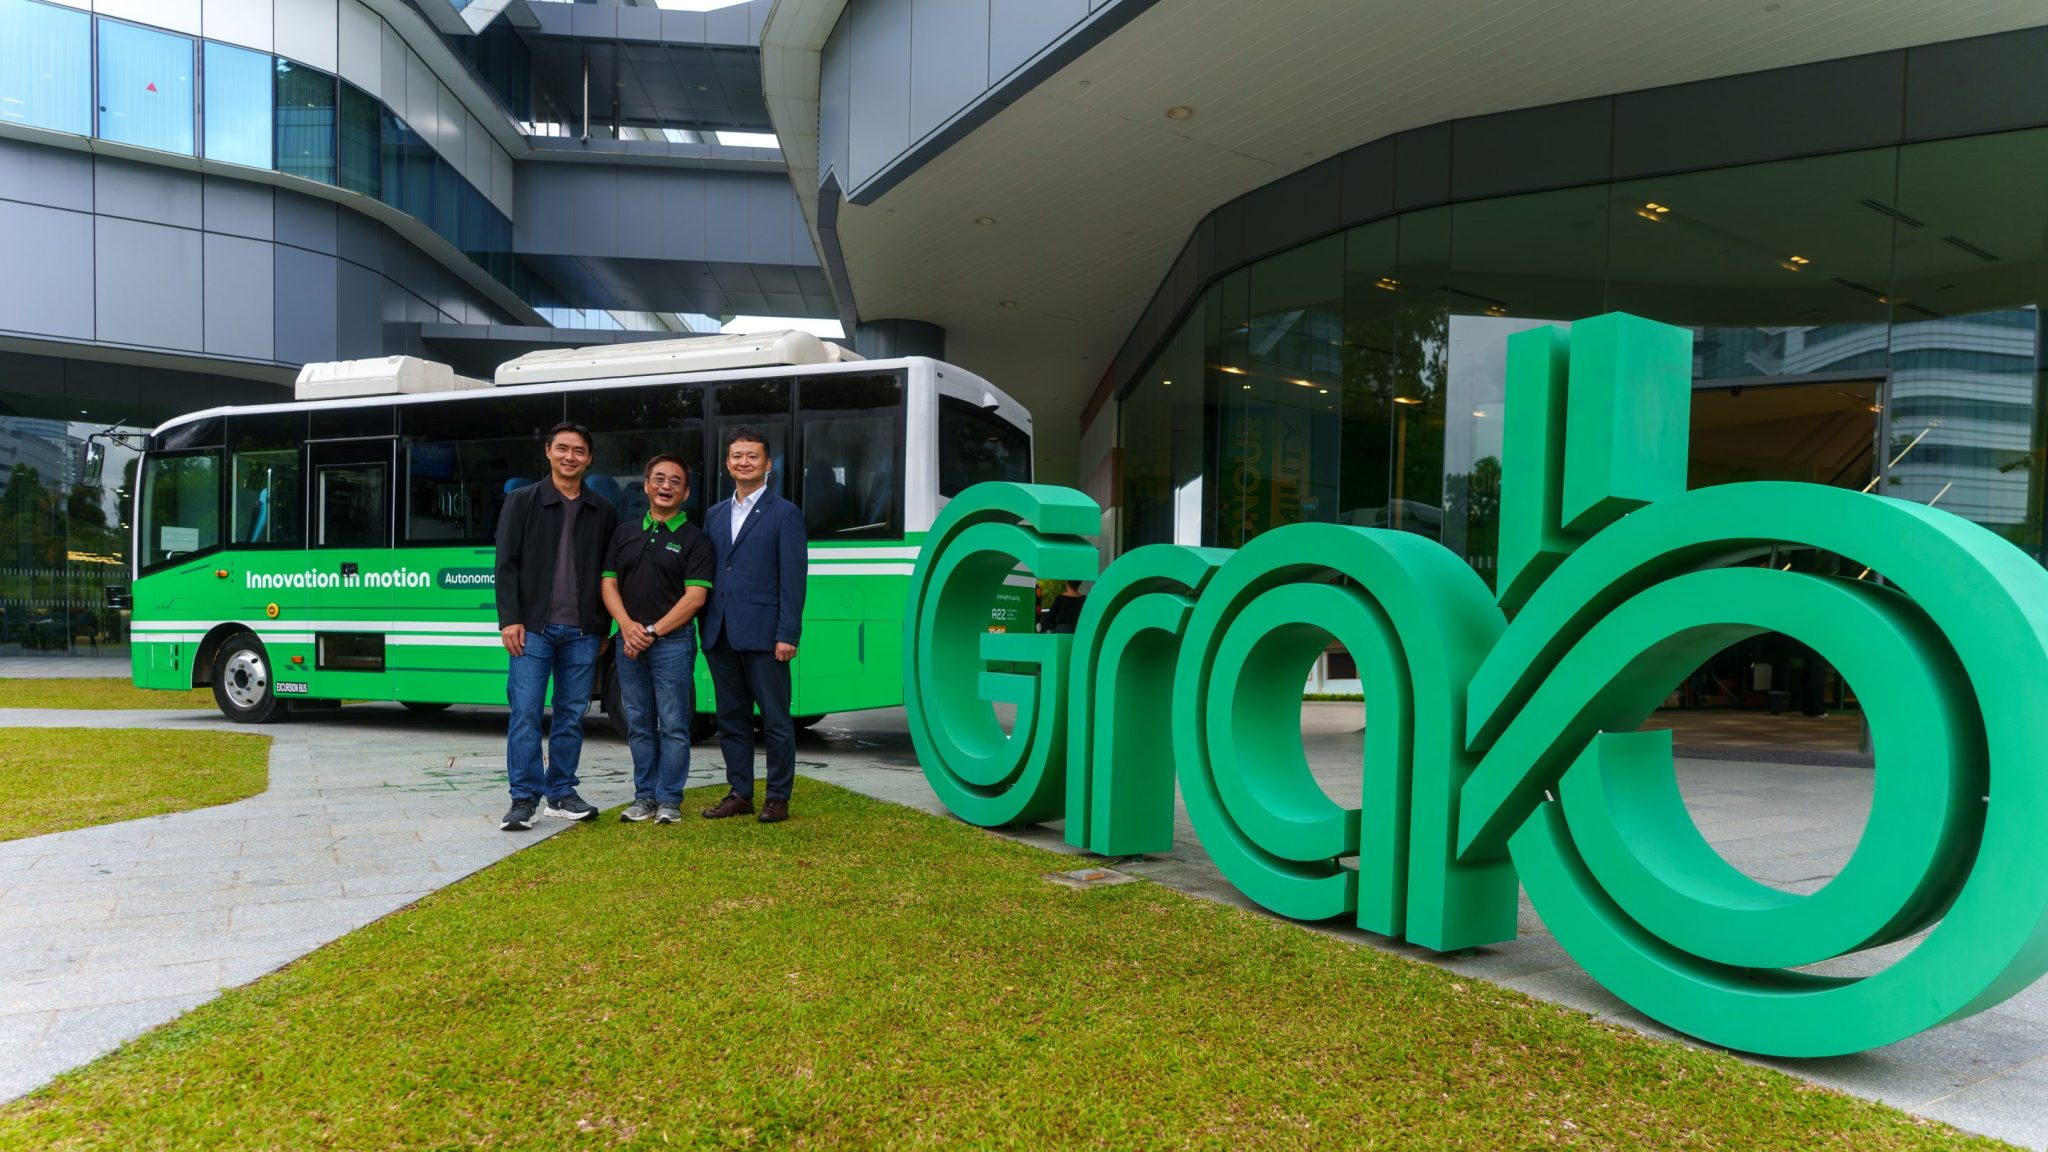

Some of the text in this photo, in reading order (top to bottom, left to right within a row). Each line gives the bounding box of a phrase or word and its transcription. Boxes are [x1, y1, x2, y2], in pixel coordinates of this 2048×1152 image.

[246, 567, 430, 588] Innovation in motion
[445, 573, 496, 584] Autonomo
[276, 682, 307, 693] EXCURSION BUS
[904, 312, 2048, 1058] Grab
